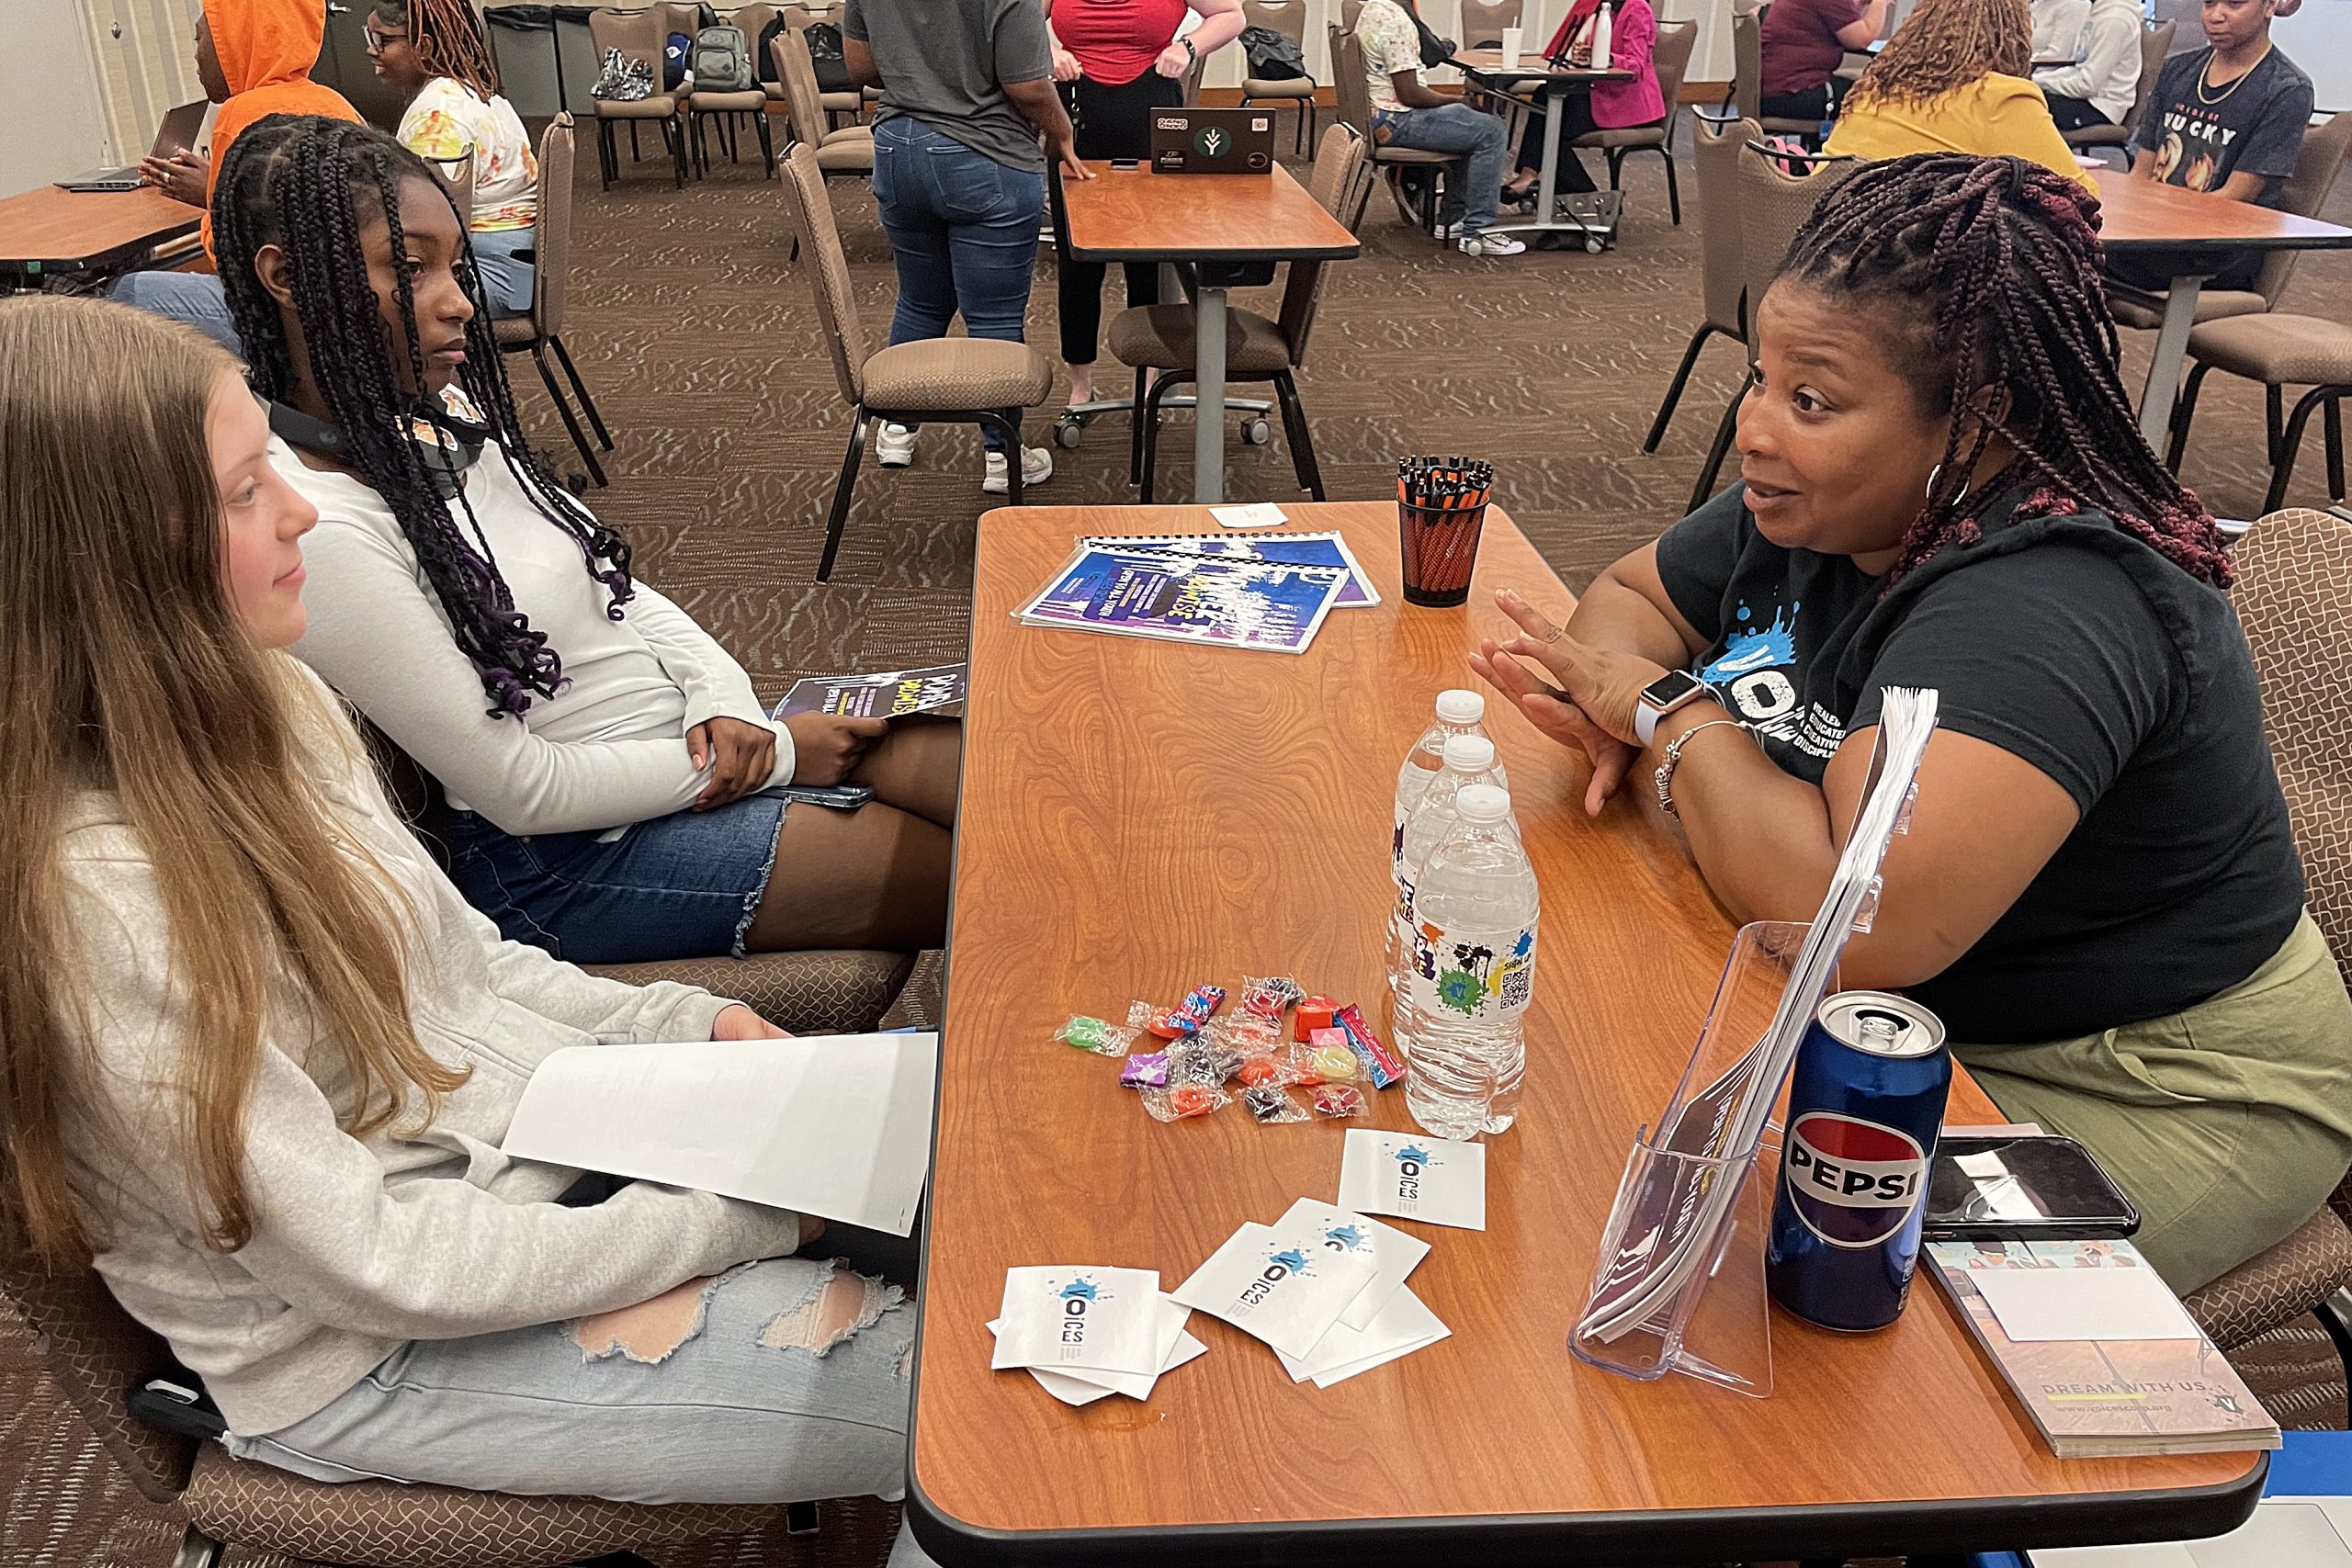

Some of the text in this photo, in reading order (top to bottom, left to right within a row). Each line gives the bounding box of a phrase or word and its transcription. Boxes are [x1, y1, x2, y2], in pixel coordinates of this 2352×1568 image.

[1792, 734, 1836, 759] DISCIPLI
[1790, 1139, 1918, 1201] PEPSI
[2041, 1383, 2115, 1394] DREAM
